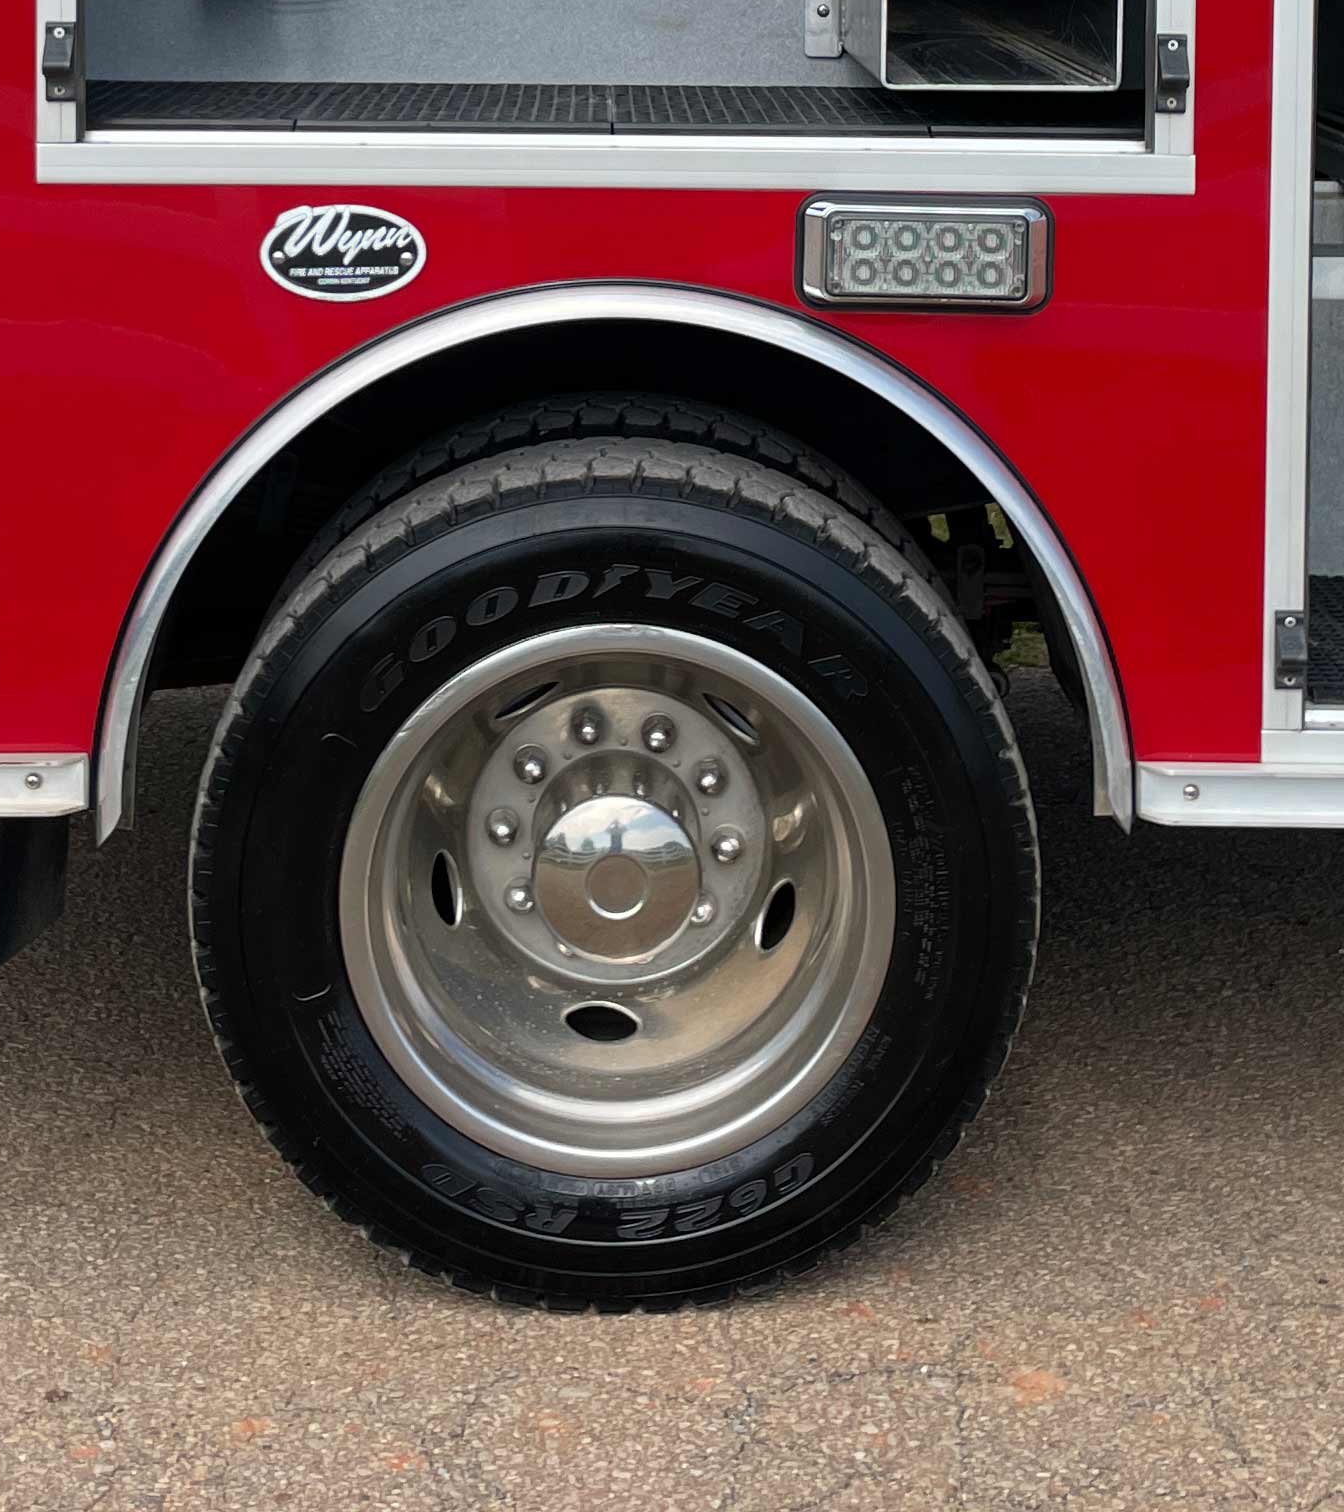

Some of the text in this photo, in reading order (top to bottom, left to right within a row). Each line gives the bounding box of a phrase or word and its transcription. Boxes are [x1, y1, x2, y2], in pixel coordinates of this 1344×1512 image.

[283, 206, 412, 265] Wynn
[289, 265, 399, 277] FIRE AND RESCUE APPARATUS
[359, 562, 870, 713] GOODYEAR
[420, 1161, 579, 1236] RSD
[616, 1152, 816, 1240] G622
